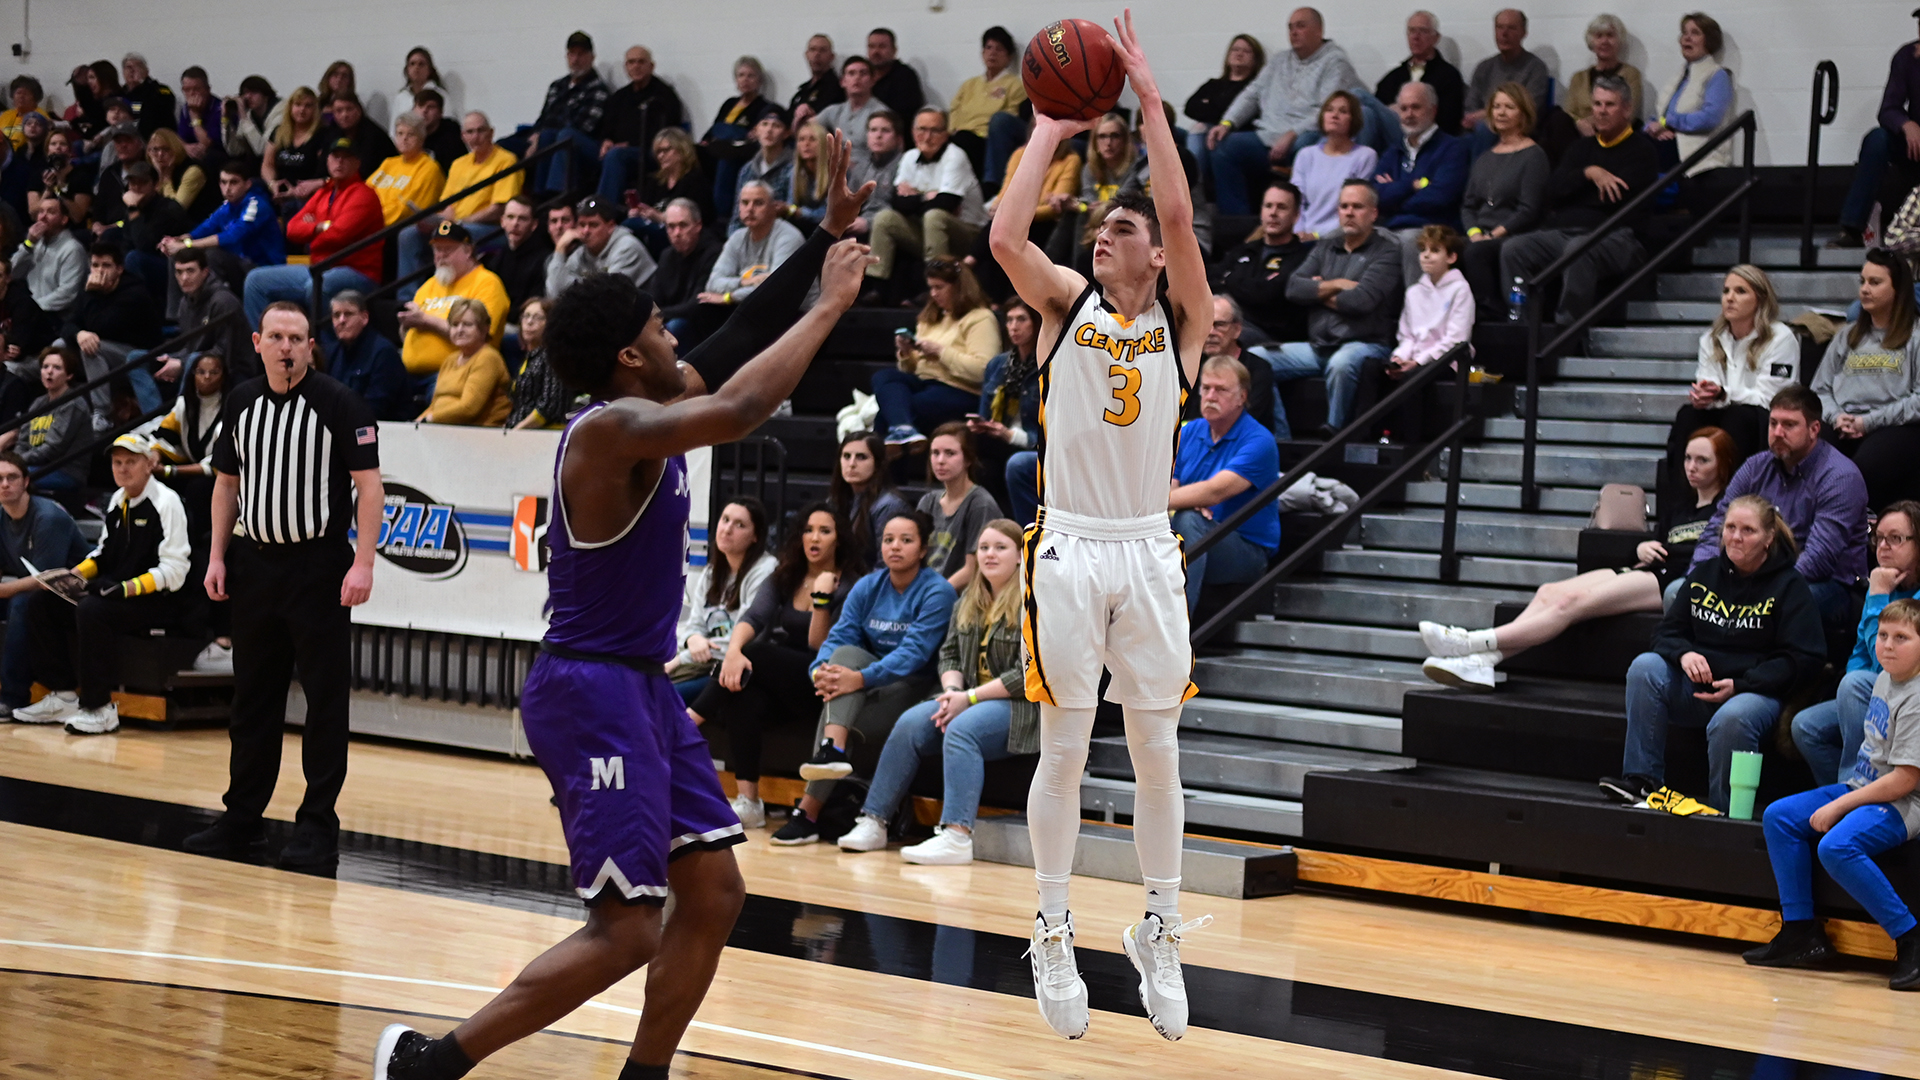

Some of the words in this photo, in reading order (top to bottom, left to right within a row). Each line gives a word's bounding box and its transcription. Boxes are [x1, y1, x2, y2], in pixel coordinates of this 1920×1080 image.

[1074, 321, 1166, 363] CENTRE
[1102, 364, 1143, 427] 3
[1040, 554, 1060, 562] adidas
[1690, 581, 1775, 619] CENTRE
[589, 756, 626, 791] M
